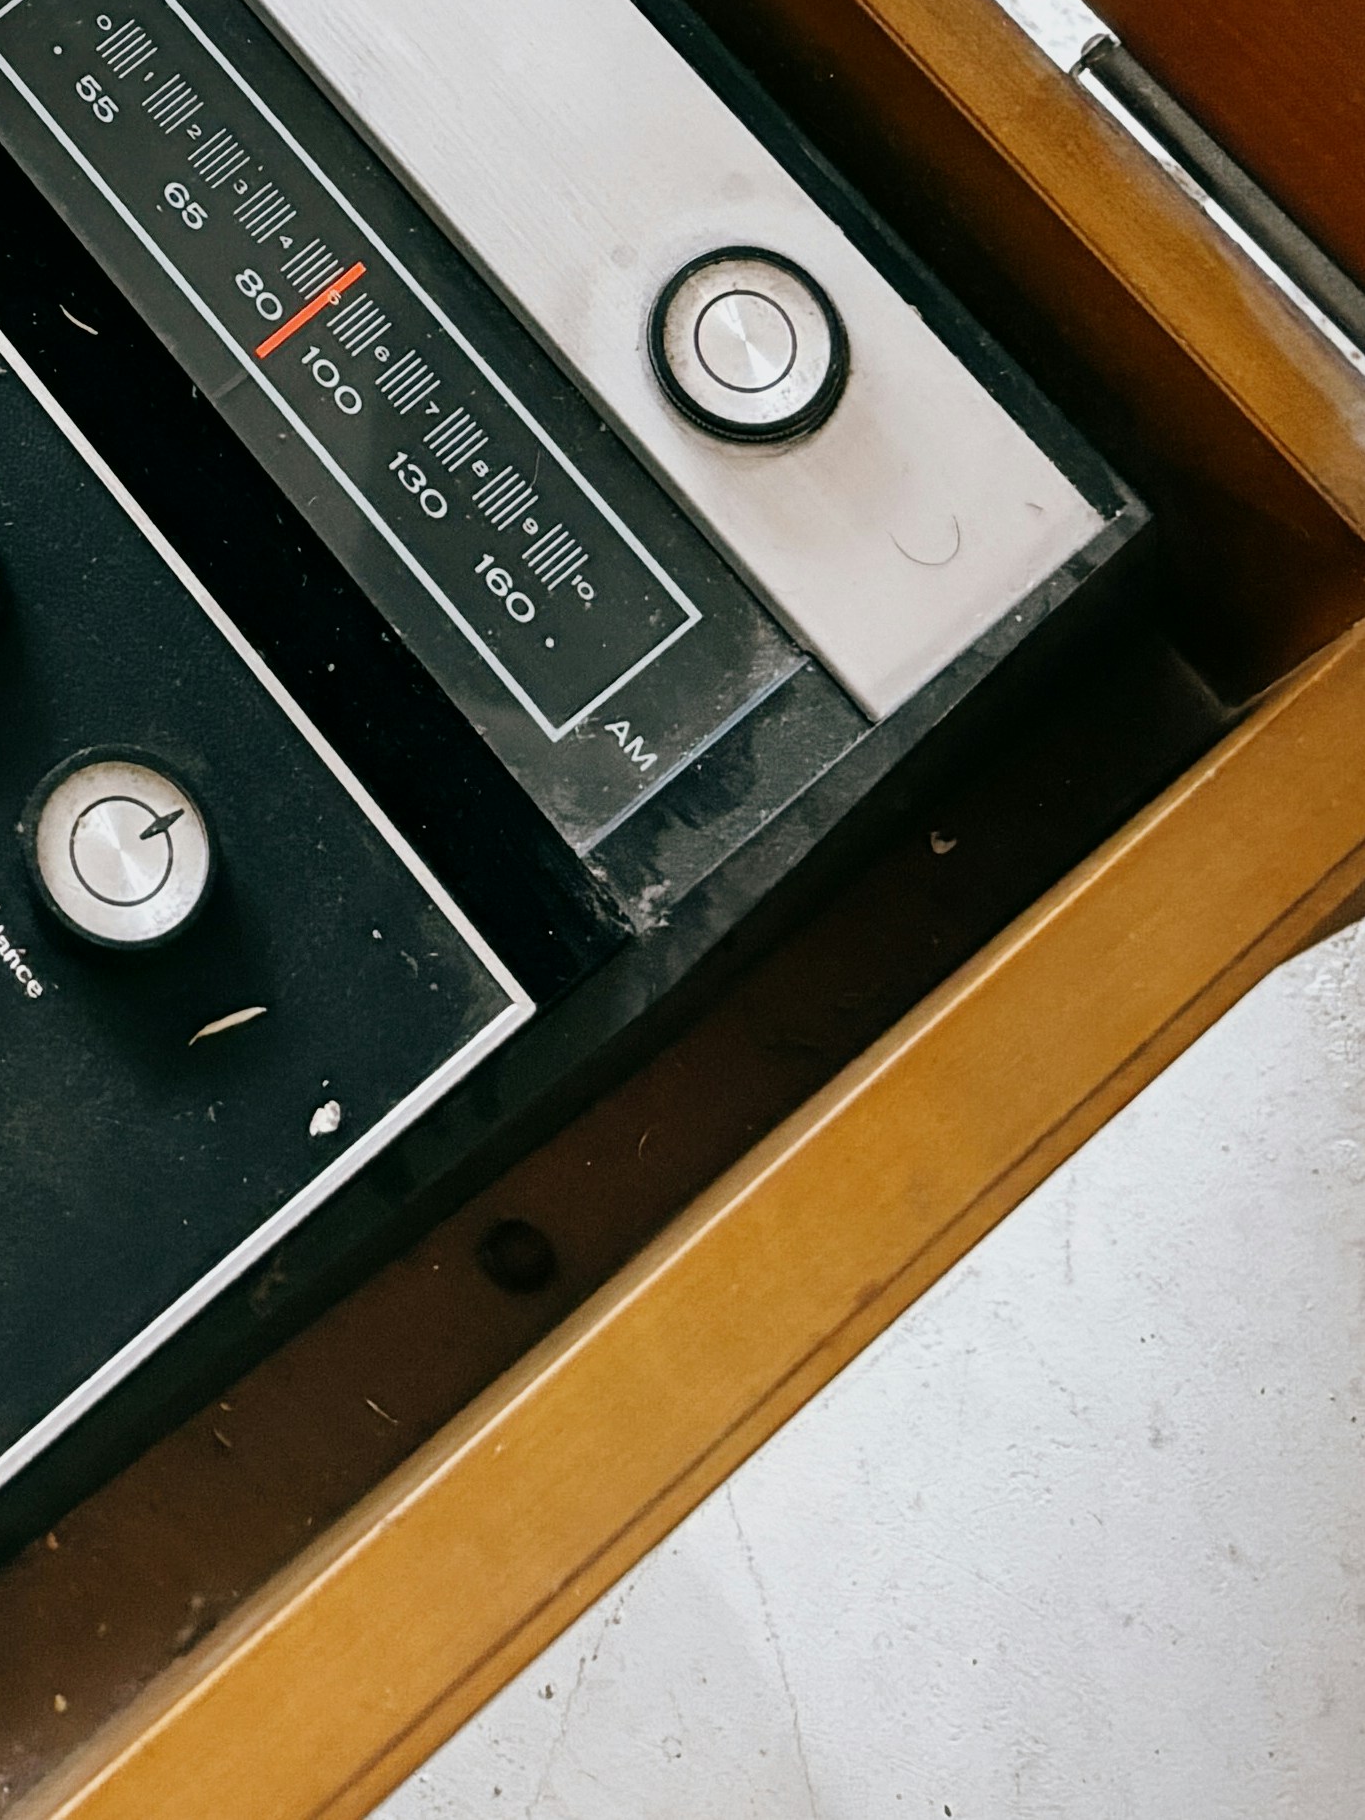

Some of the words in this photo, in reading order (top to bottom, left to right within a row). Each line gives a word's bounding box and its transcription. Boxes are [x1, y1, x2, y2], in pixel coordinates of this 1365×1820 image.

[74, 73, 120, 123] 55
[163, 181, 209, 230] 65
[234, 267, 283, 321] 80
[300, 345, 362, 415] 100
[387, 450, 448, 519] 130
[473, 552, 536, 623] 160
[185, 123, 202, 140] 2
[232, 178, 248, 195] 3
[278, 234, 294, 249] 4
[373, 344, 390, 362] 6
[424, 399, 440, 415] 7
[470, 458, 489, 478] 8
[521, 516, 539, 535] 9
[570, 573, 595, 601] 10
[603, 720, 658, 772] AM
